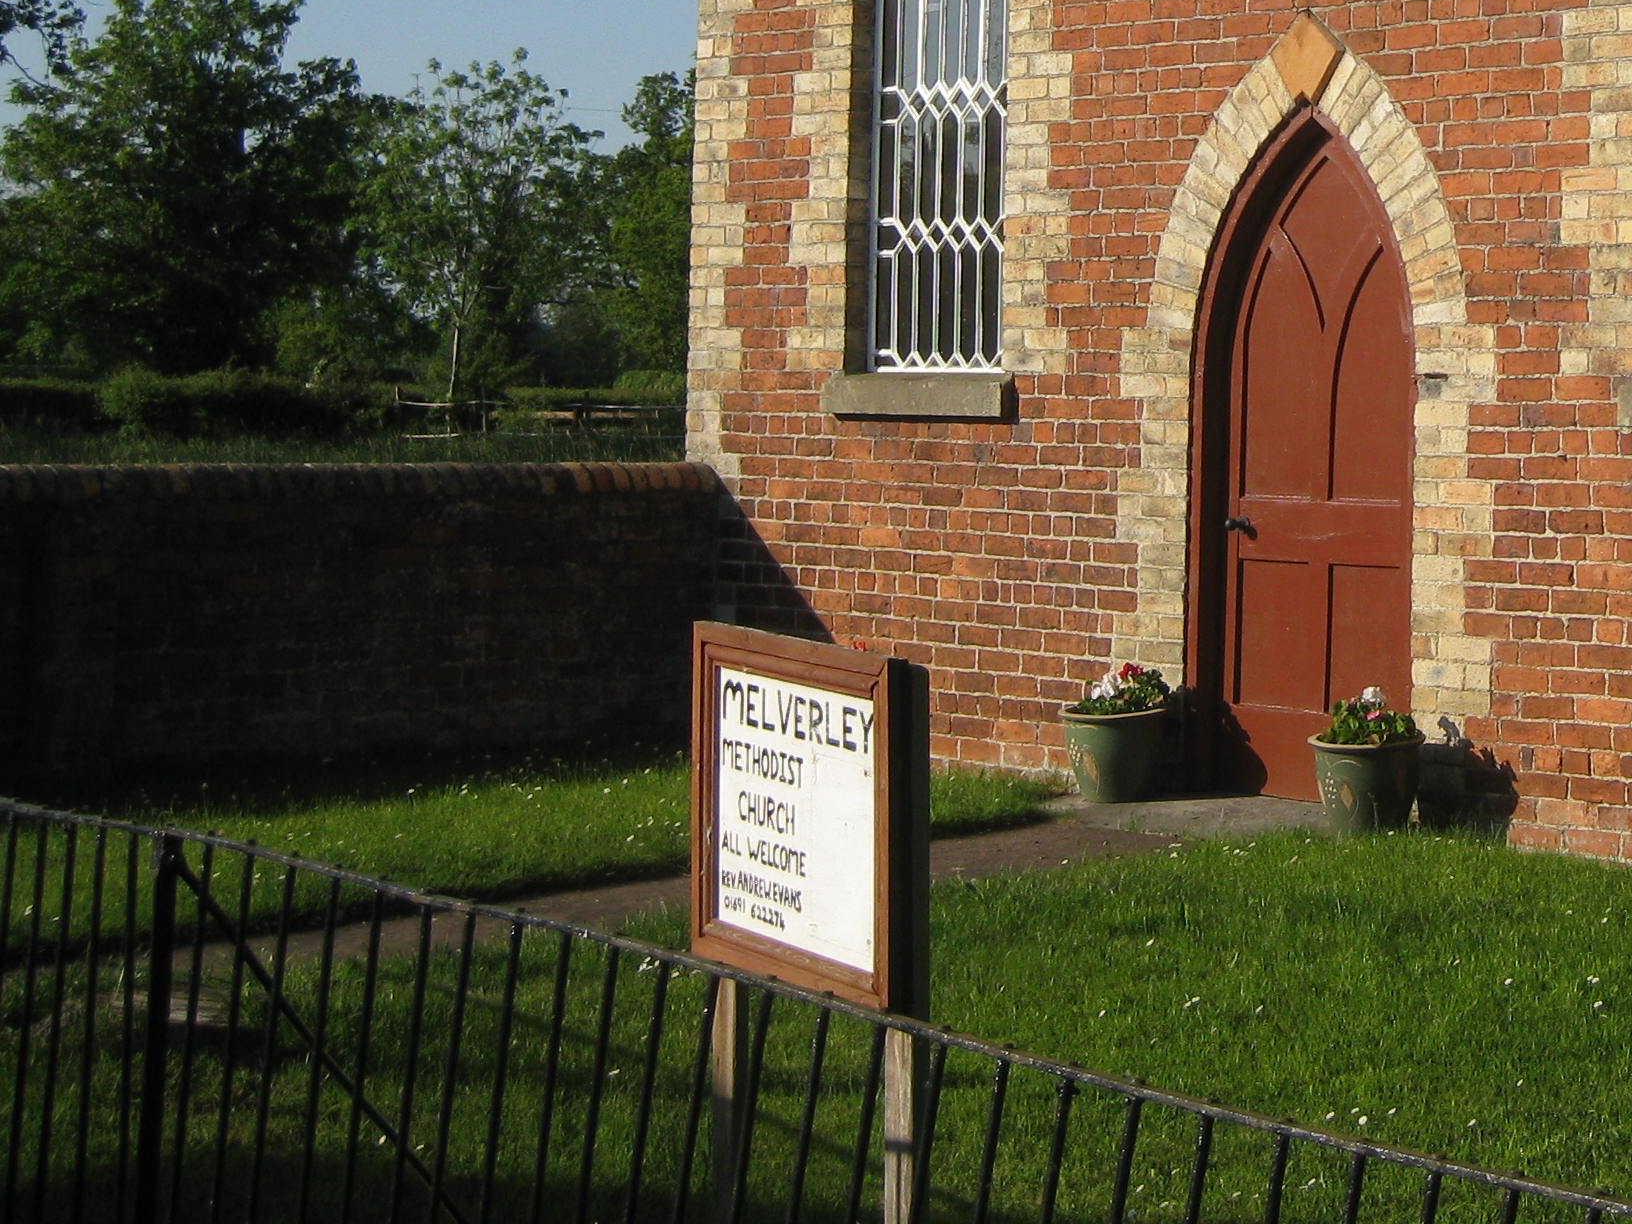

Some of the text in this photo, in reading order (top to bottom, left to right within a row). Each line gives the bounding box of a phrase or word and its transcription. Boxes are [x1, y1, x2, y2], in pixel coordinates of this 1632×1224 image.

[723, 678, 874, 754] MELVERLEY
[722, 737, 804, 788] METHODIST
[738, 790, 795, 836] CHURCH
[722, 830, 807, 878] ALL WELCOME
